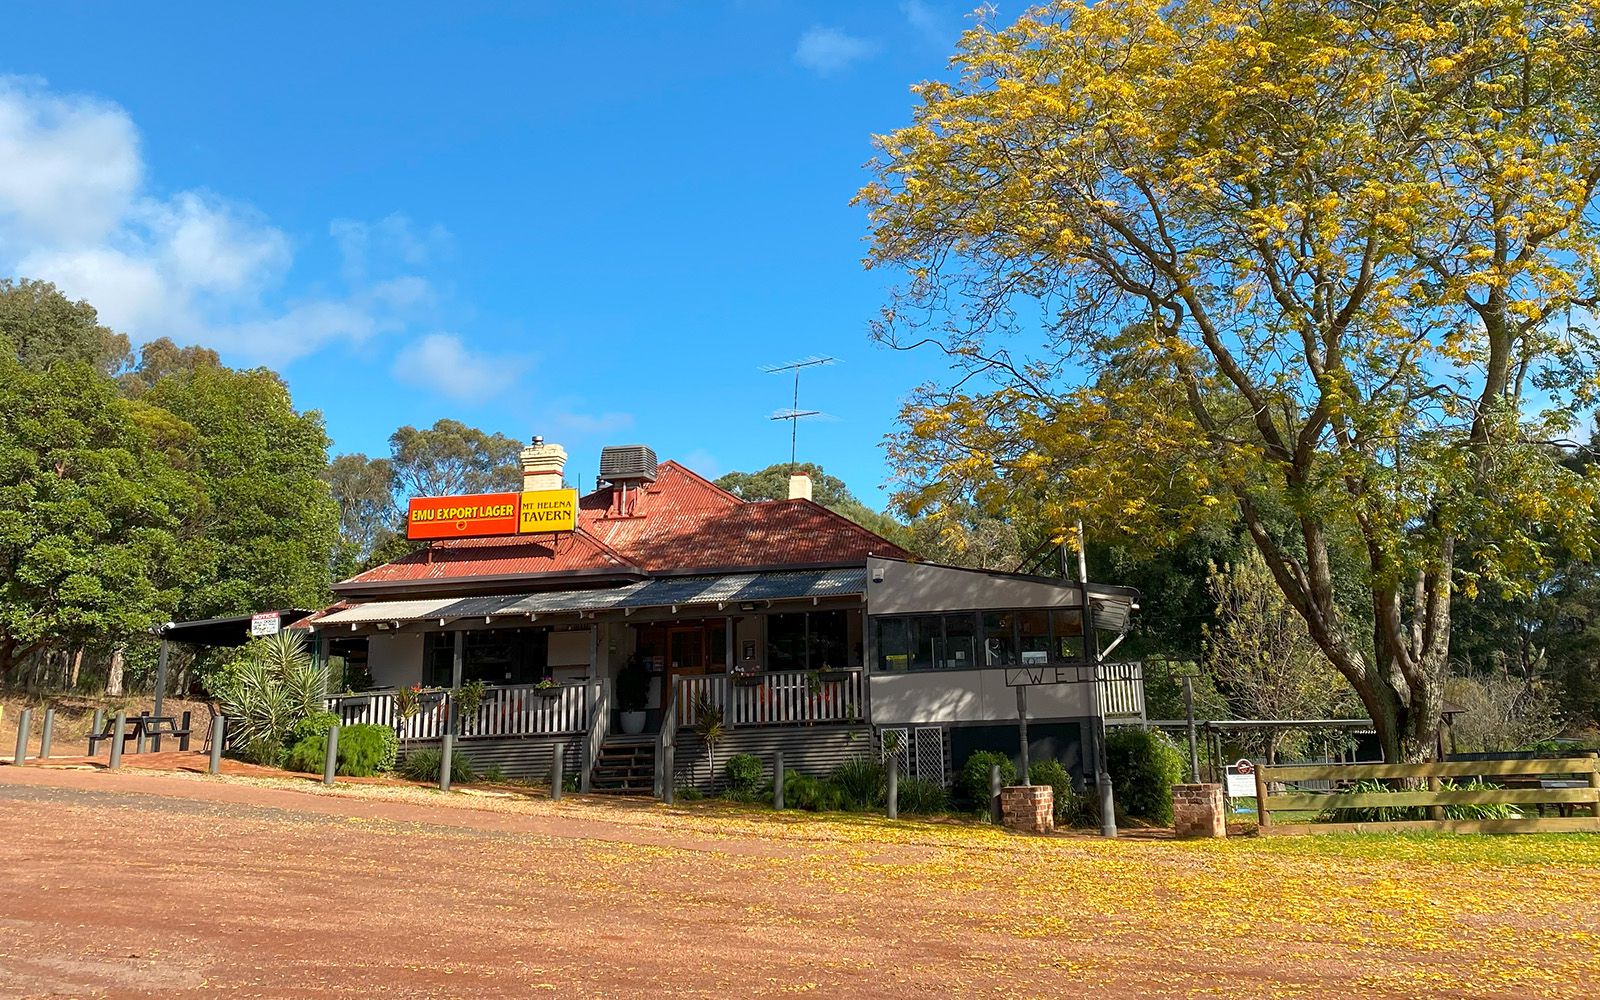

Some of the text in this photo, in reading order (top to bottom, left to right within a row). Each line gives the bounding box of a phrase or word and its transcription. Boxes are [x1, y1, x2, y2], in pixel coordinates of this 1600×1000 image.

[537, 501, 571, 509] HELENA
[411, 504, 514, 521] EMU EXPORT LAGER
[522, 510, 571, 522] TAVERN
